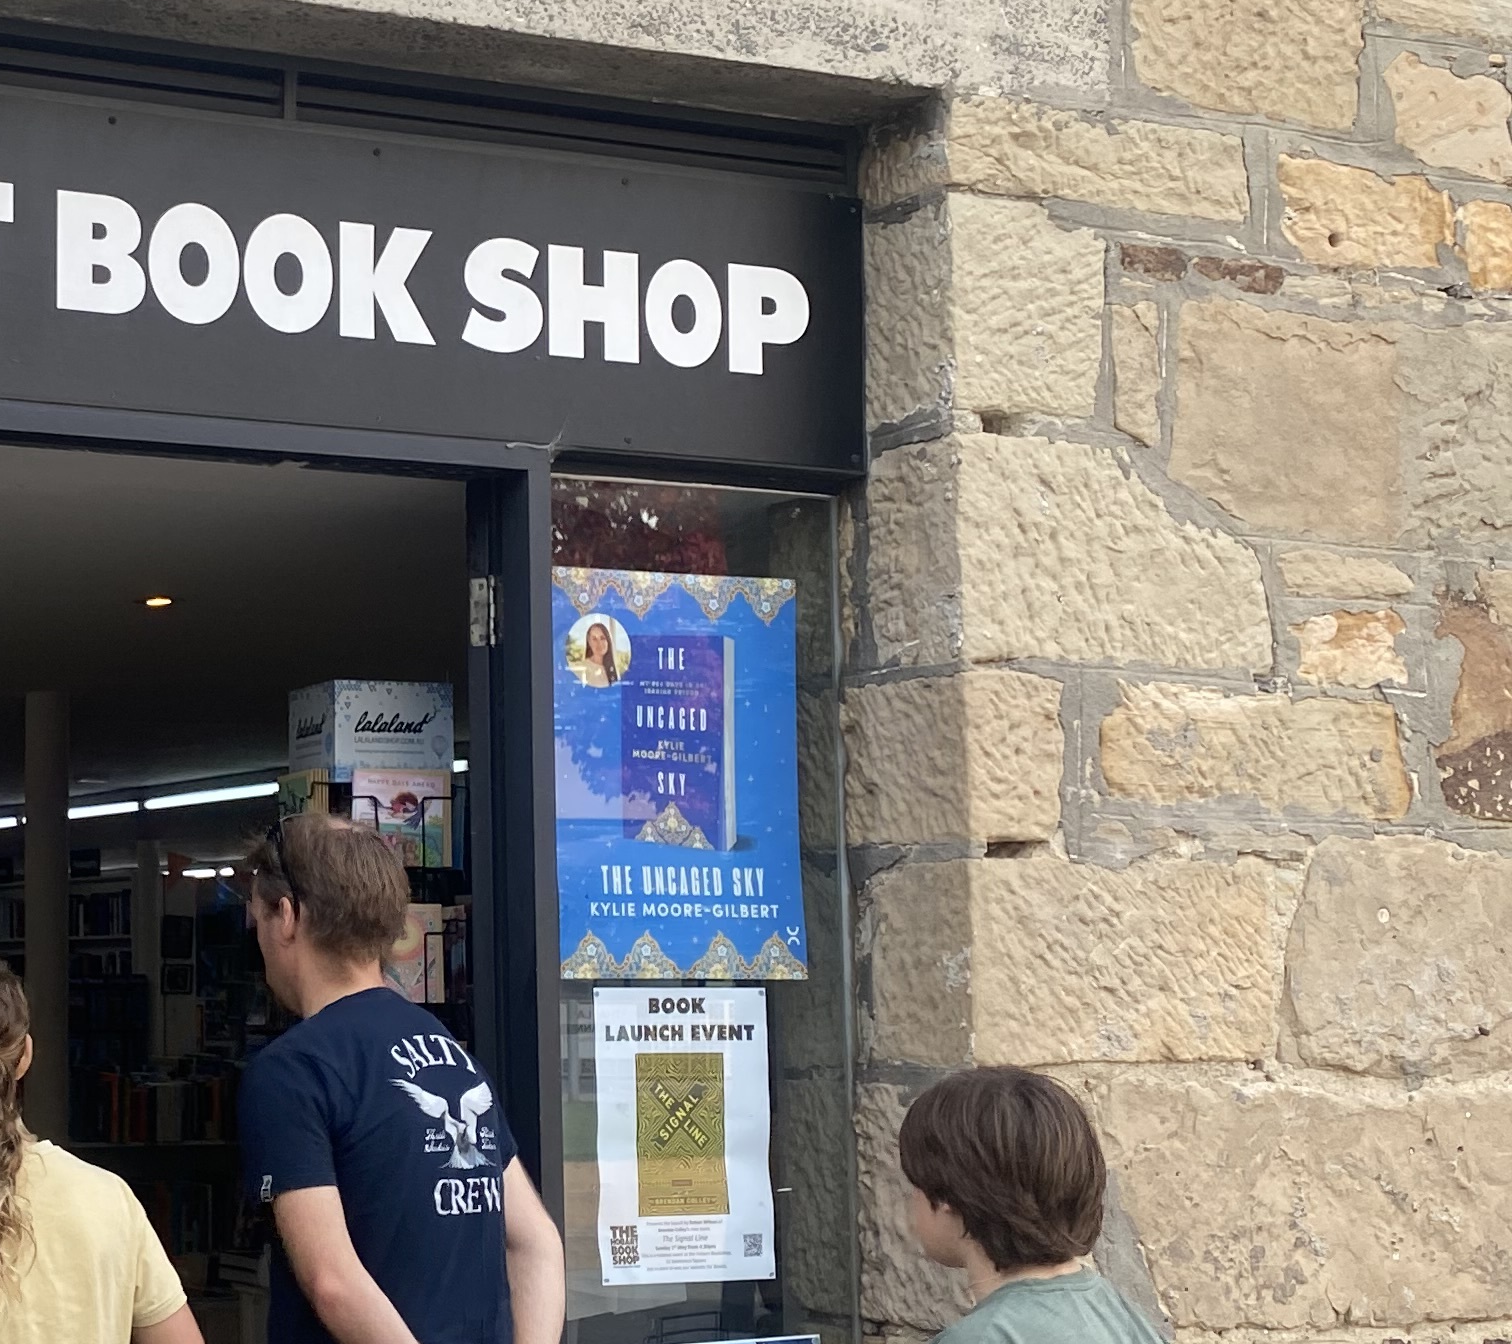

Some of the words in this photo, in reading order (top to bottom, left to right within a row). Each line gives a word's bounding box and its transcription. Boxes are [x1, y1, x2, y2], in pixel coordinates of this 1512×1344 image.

[56, 189, 437, 347] BOOK
[460, 236, 811, 376] SHOP
[657, 647, 685, 671] THE
[636, 705, 707, 732] UNCAGED
[657, 740, 685, 752] KYLIE
[657, 770, 686, 796] SKY
[600, 864, 633, 895] THE
[641, 865, 723, 897] UNCAGED
[732, 867, 764, 897] SKY
[590, 901, 636, 917] KYLIE
[642, 903, 779, 919] MOORE-GILBERT
[648, 997, 706, 1014] BOOK
[605, 1024, 684, 1042] LAUNCH
[690, 1024, 755, 1042] EVENT
[653, 1082, 675, 1110] THE
[659, 1093, 700, 1141] SIGNAL
[683, 1118, 708, 1148] LINE
[433, 1177, 502, 1216] CREW
[609, 1225, 637, 1239] THE
[611, 1245, 639, 1256] BOOK
[612, 1255, 640, 1266] SHOP
